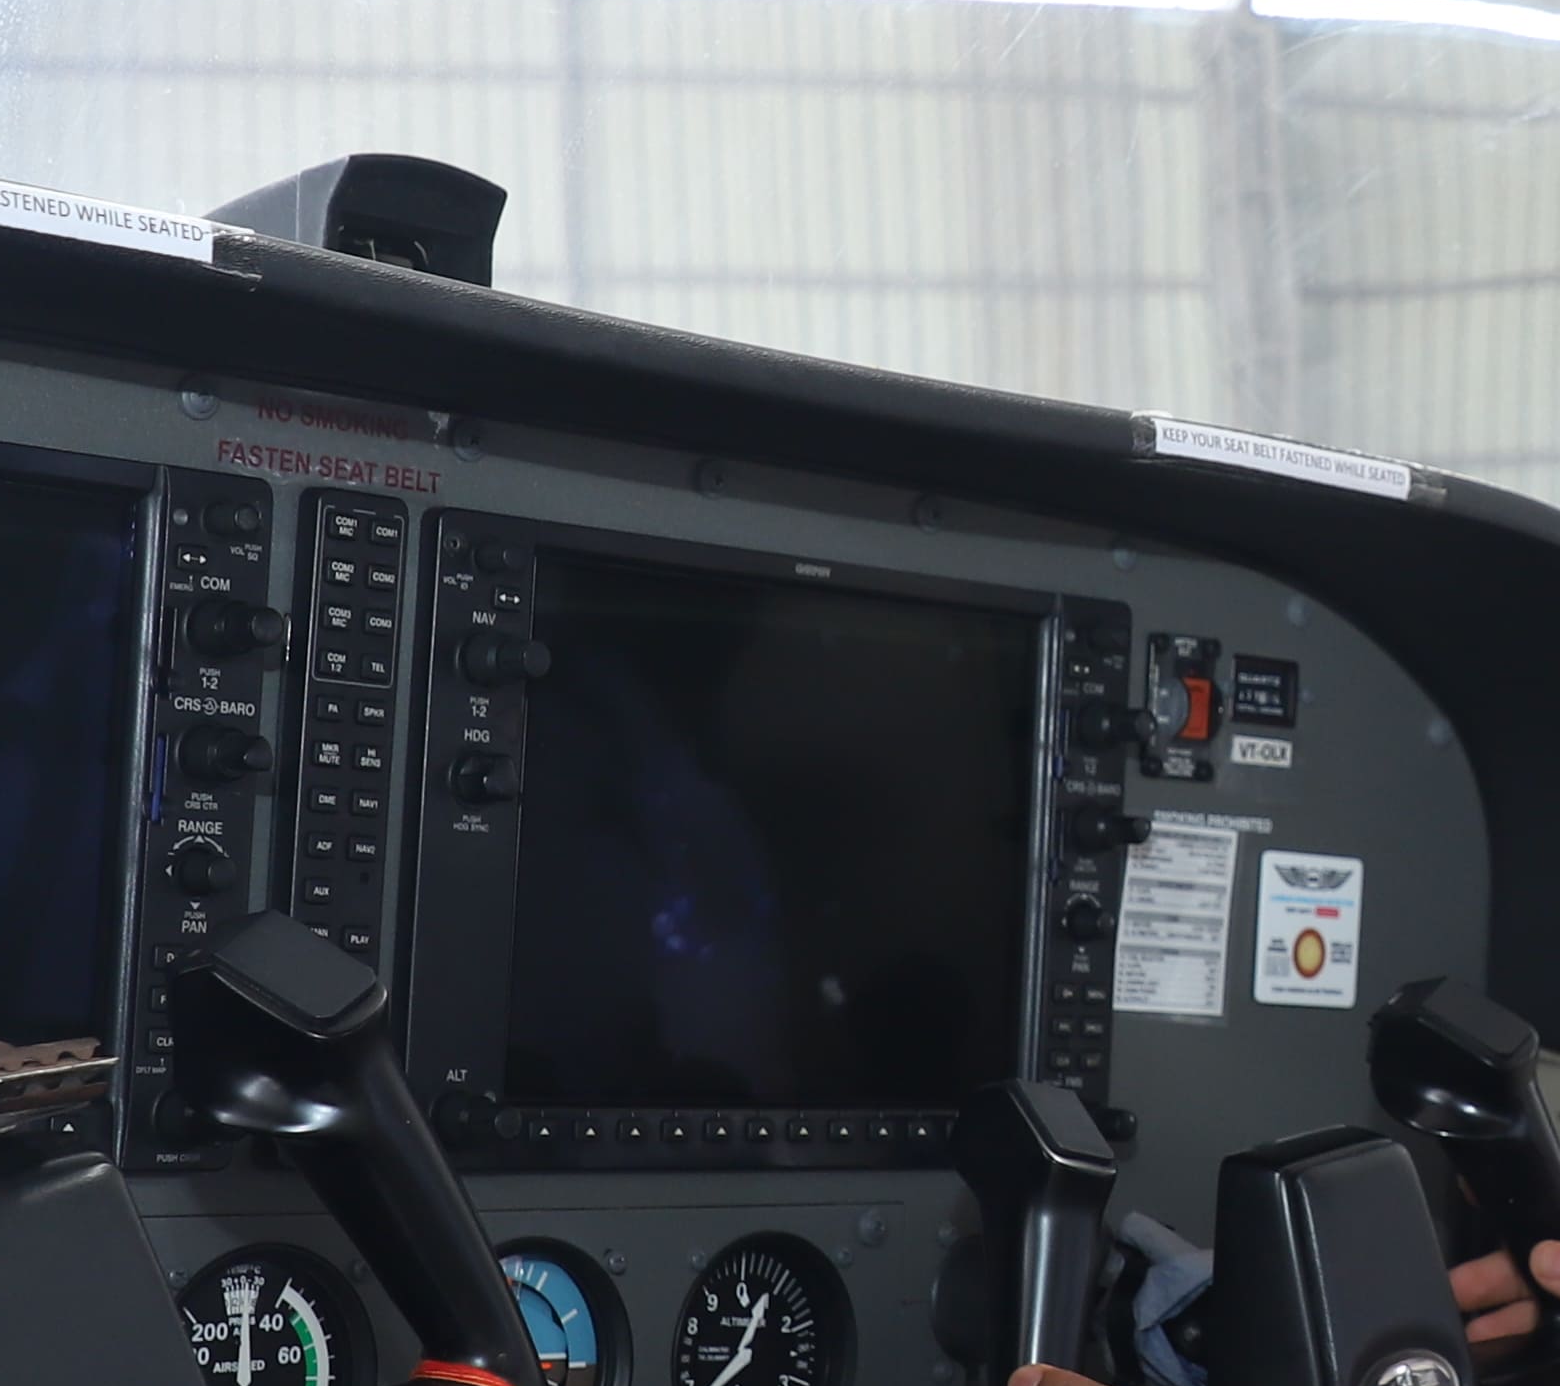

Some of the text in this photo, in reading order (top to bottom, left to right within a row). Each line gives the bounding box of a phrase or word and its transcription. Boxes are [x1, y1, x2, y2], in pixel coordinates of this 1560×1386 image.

[75, 203, 132, 230] WHILE
[138, 216, 204, 243] SEATED
[257, 397, 410, 441] NO SMOKING
[1162, 427, 1407, 487] KEEP YOUR SEAT BELT FASTENED WHILE SEATED
[218, 441, 441, 494] FASTEN SEAT BELT
[335, 514, 358, 527] COM1
[376, 525, 398, 538] COM1
[200, 575, 231, 593] COM
[372, 571, 396, 585] COM2
[472, 611, 497, 626] NAV
[201, 675, 219, 691] 1-2
[174, 697, 256, 718] CRS BARO
[327, 702, 340, 714] PA
[471, 706, 488, 718] 1-2
[464, 728, 491, 744] HDG
[178, 818, 224, 836] RANGE
[312, 885, 331, 897] AUX
[181, 919, 208, 934] PAN
[706, 1293, 719, 1313] 9
[258, 1312, 285, 1333] 40
[686, 1316, 699, 1336] 8
[780, 1315, 793, 1334] 2
[191, 1321, 229, 1343] 200
[277, 1345, 302, 1365] 60
